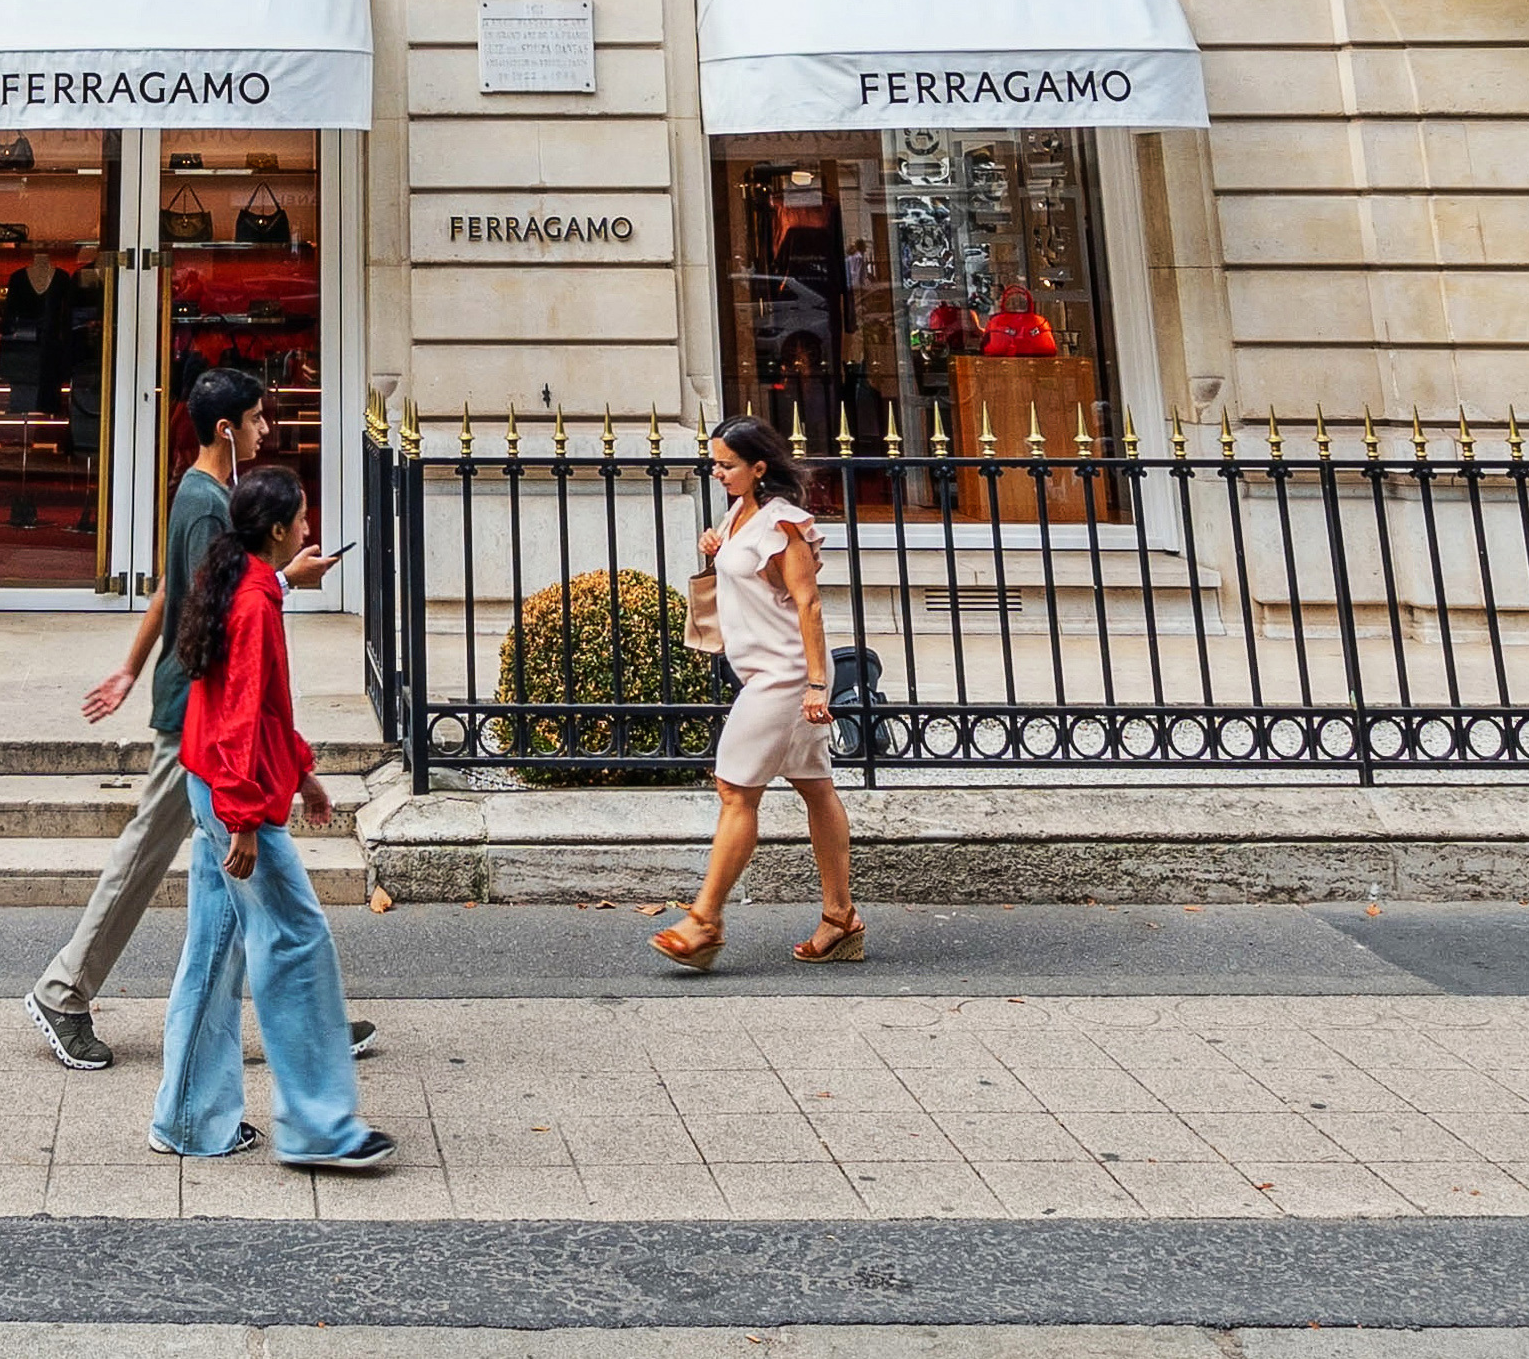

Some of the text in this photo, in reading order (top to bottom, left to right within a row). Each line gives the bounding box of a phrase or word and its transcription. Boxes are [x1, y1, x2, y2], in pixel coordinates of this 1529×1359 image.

[2, 72, 269, 105] FERRAGAMO
[860, 71, 1131, 105] FERRAGAMO
[451, 217, 632, 242] FERRAGAMO
